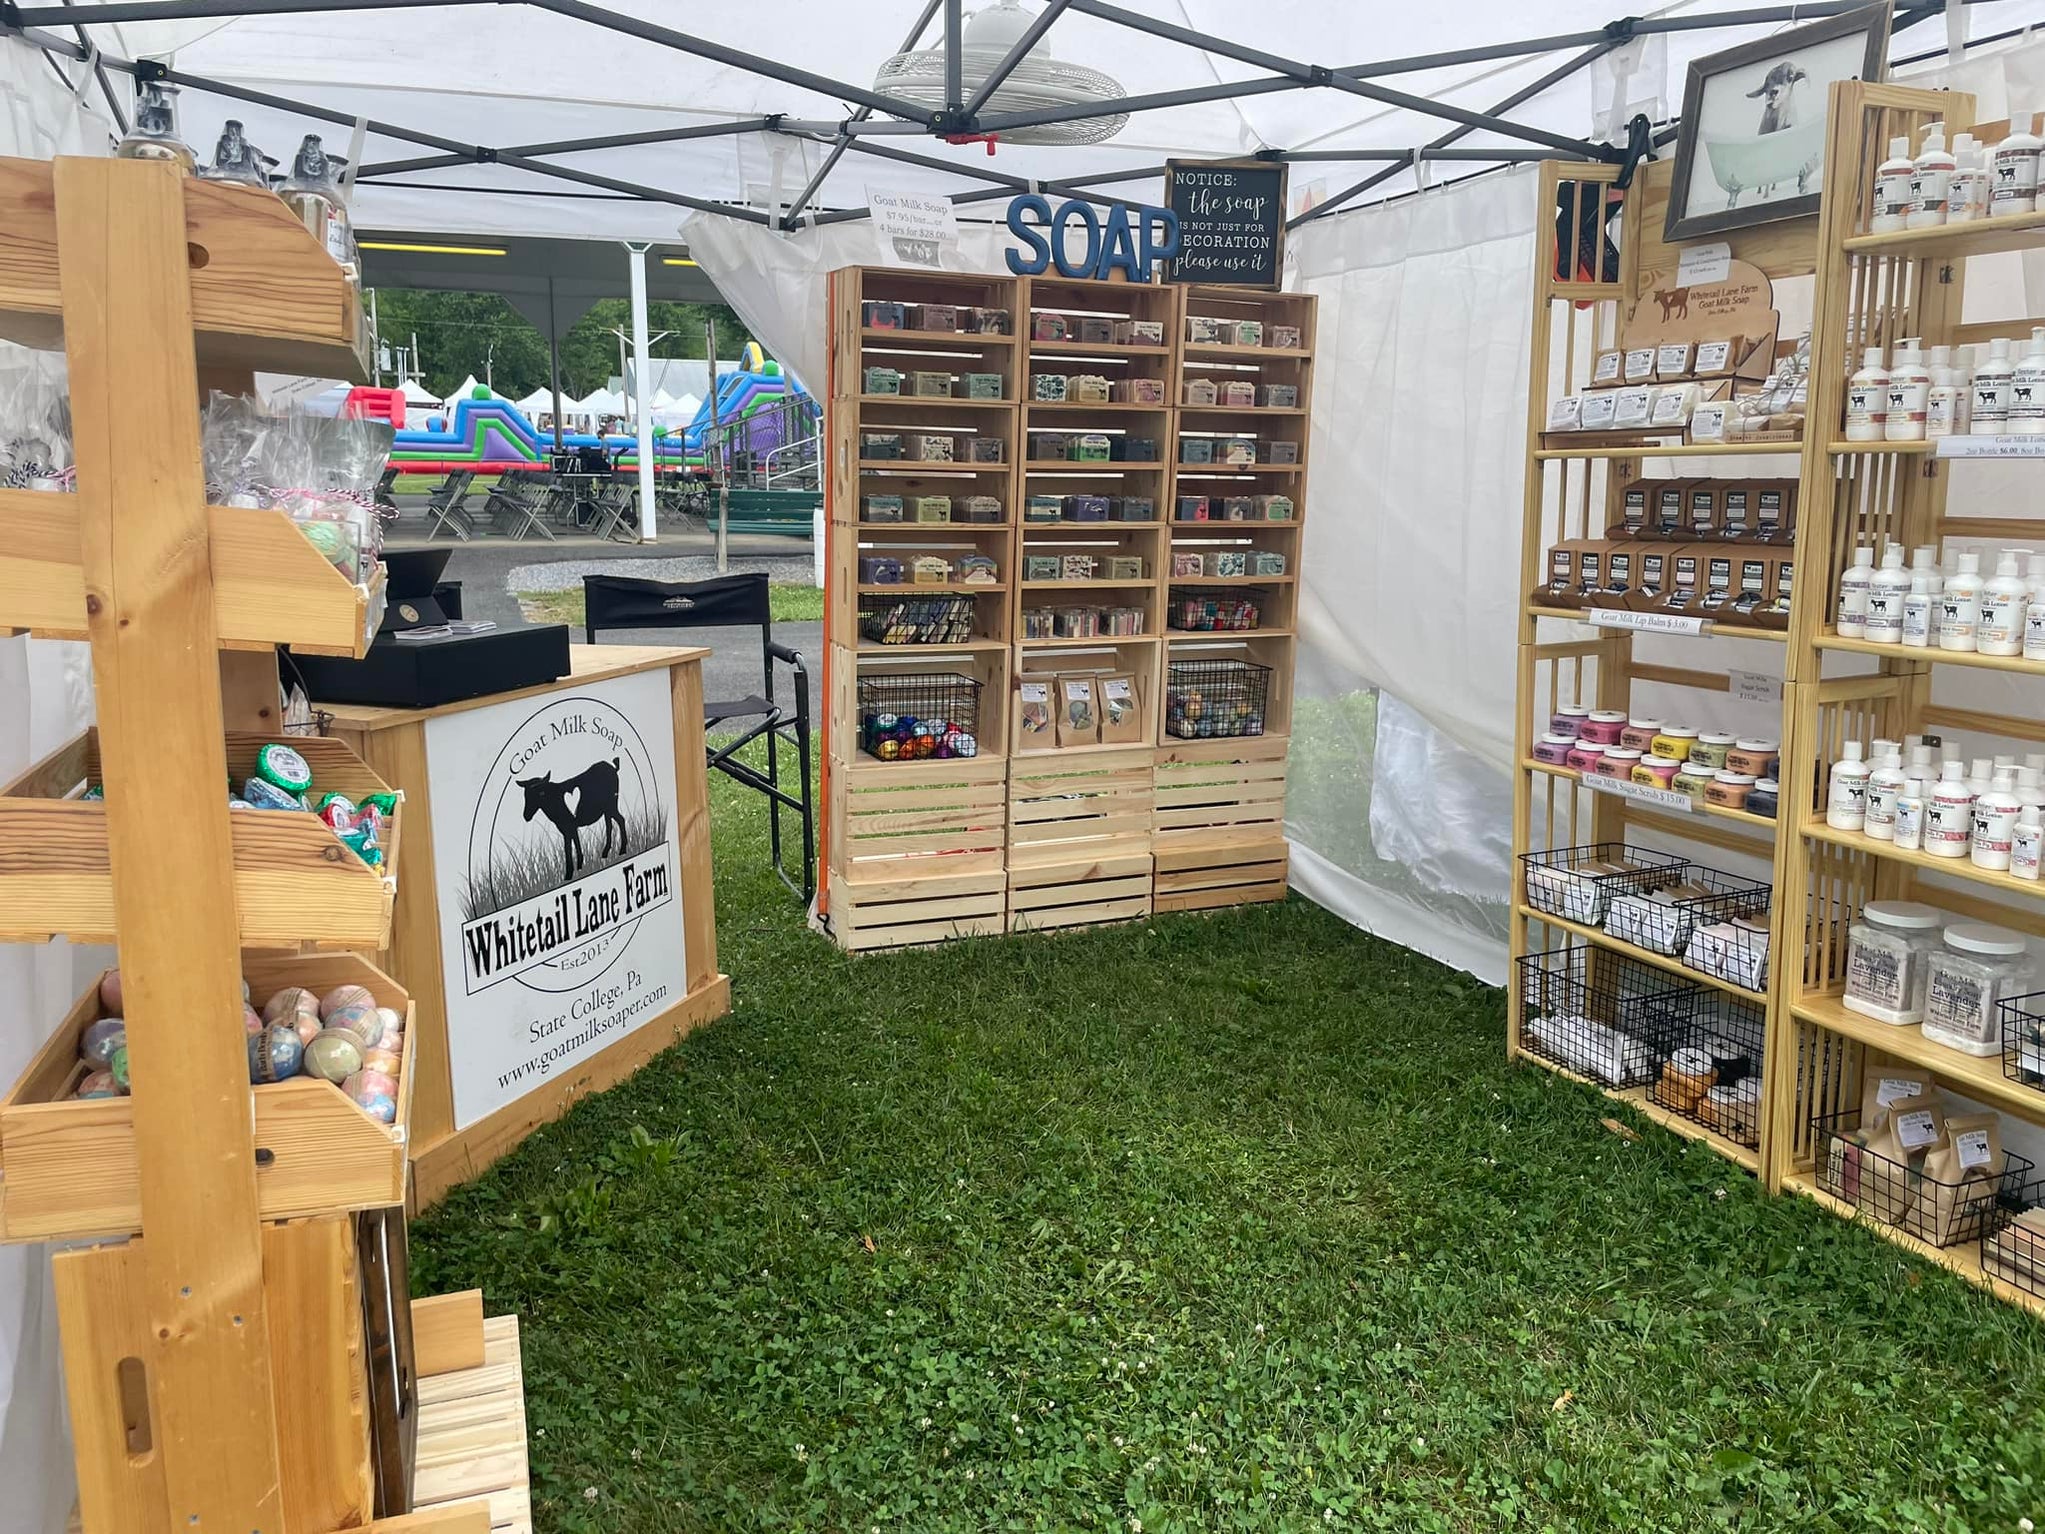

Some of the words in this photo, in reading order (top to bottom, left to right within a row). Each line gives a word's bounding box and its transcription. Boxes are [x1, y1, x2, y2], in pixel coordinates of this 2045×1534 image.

[1175, 172, 1237, 187] NOTICE:
[874, 194, 897, 207] Goat
[900, 198, 922, 211] Milk
[923, 202, 948, 217] Soap
[1188, 188, 1222, 216] the
[1224, 196, 1269, 220] soap
[887, 224, 905, 235] bars
[906, 226, 918, 237] for
[1005, 193, 1179, 283] SOAP
[1192, 222, 1213, 231] NOT
[1216, 222, 1241, 232] JUST
[1244, 223, 1265, 233] FOR
[1182, 234, 1270, 249] ECORATION
[1173, 249, 1222, 277] please
[1223, 257, 1249, 271] use
[1251, 254, 1267, 271] it
[1619, 613, 1634, 623] Milk
[509, 734, 548, 775] Goat
[550, 714, 588, 740] Milk
[591, 716, 623, 751] Soap
[465, 893, 571, 978] Whitetail
[572, 887, 621, 939] Lane
[622, 862, 669, 915] Farm
[1853, 958, 1898, 980] Lavender
[529, 1014, 567, 1044] State
[570, 985, 624, 1021] College,
[626, 970, 642, 991] Pa
[1932, 984, 1981, 1008] Lavender
[497, 984, 668, 1089] www.goatmilksoaper.com
